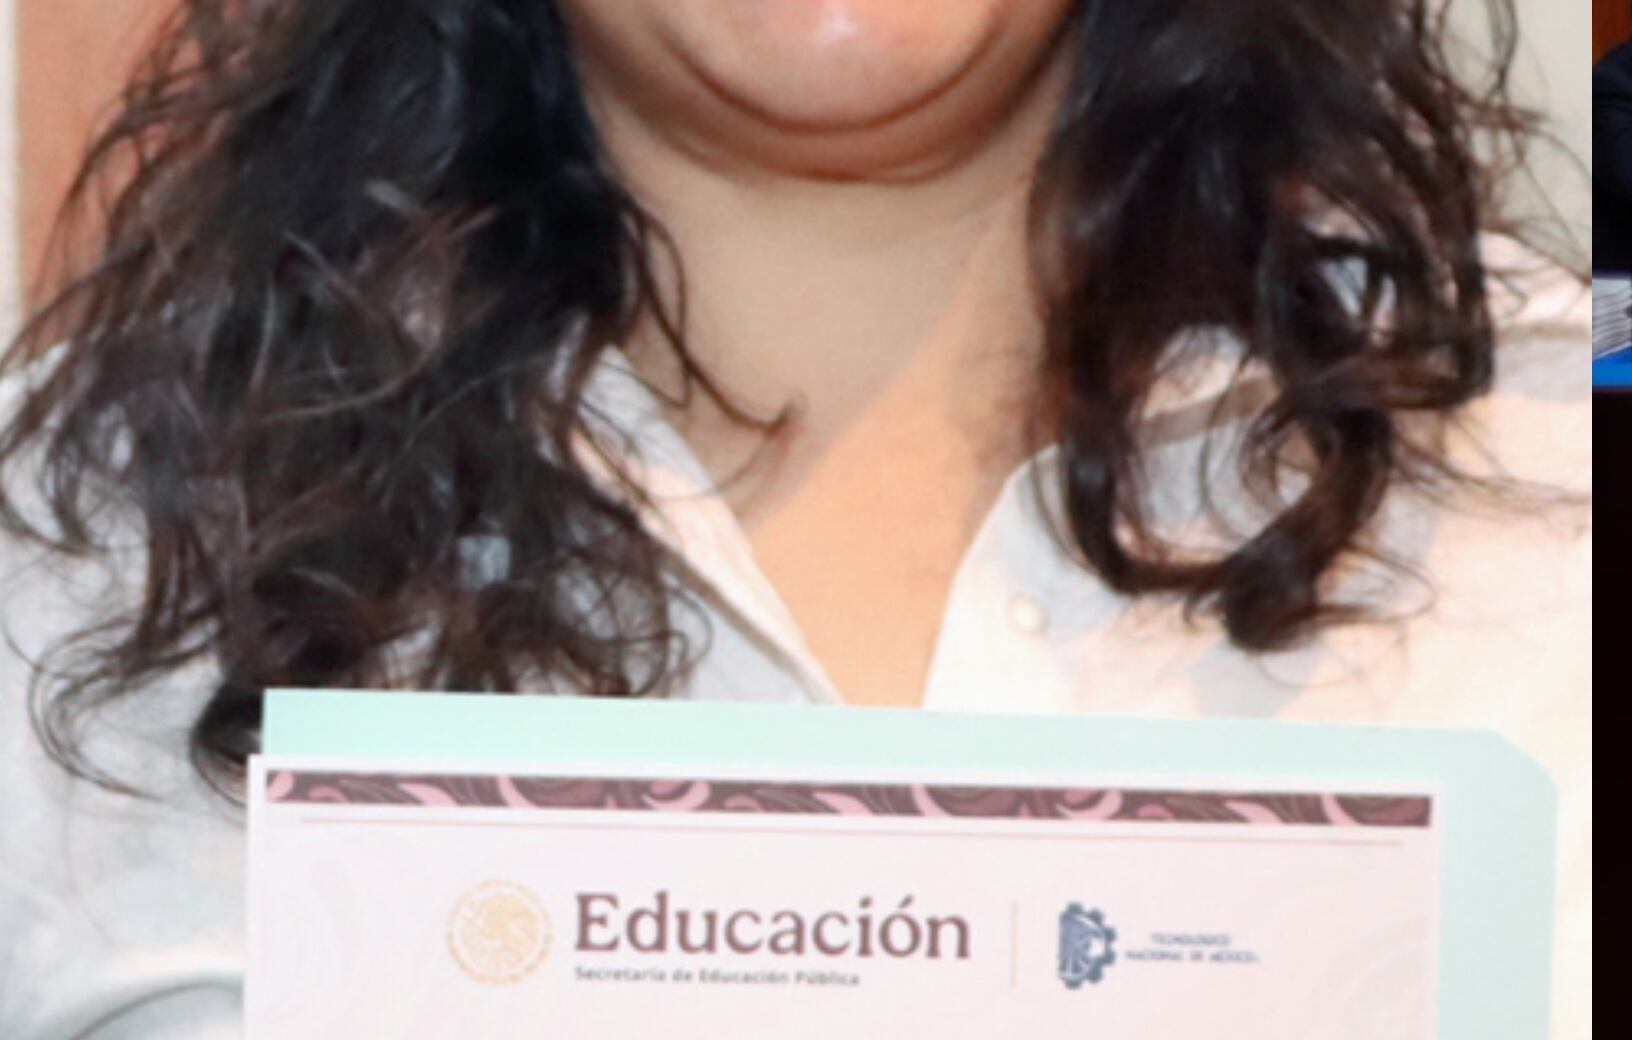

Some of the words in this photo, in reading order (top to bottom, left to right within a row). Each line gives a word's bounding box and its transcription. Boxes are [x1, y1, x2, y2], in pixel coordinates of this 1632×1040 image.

[574, 890, 971, 960] Educación
[672, 968, 693, 983] de
[698, 968, 790, 985] Educación
[795, 970, 861, 987] Pública
